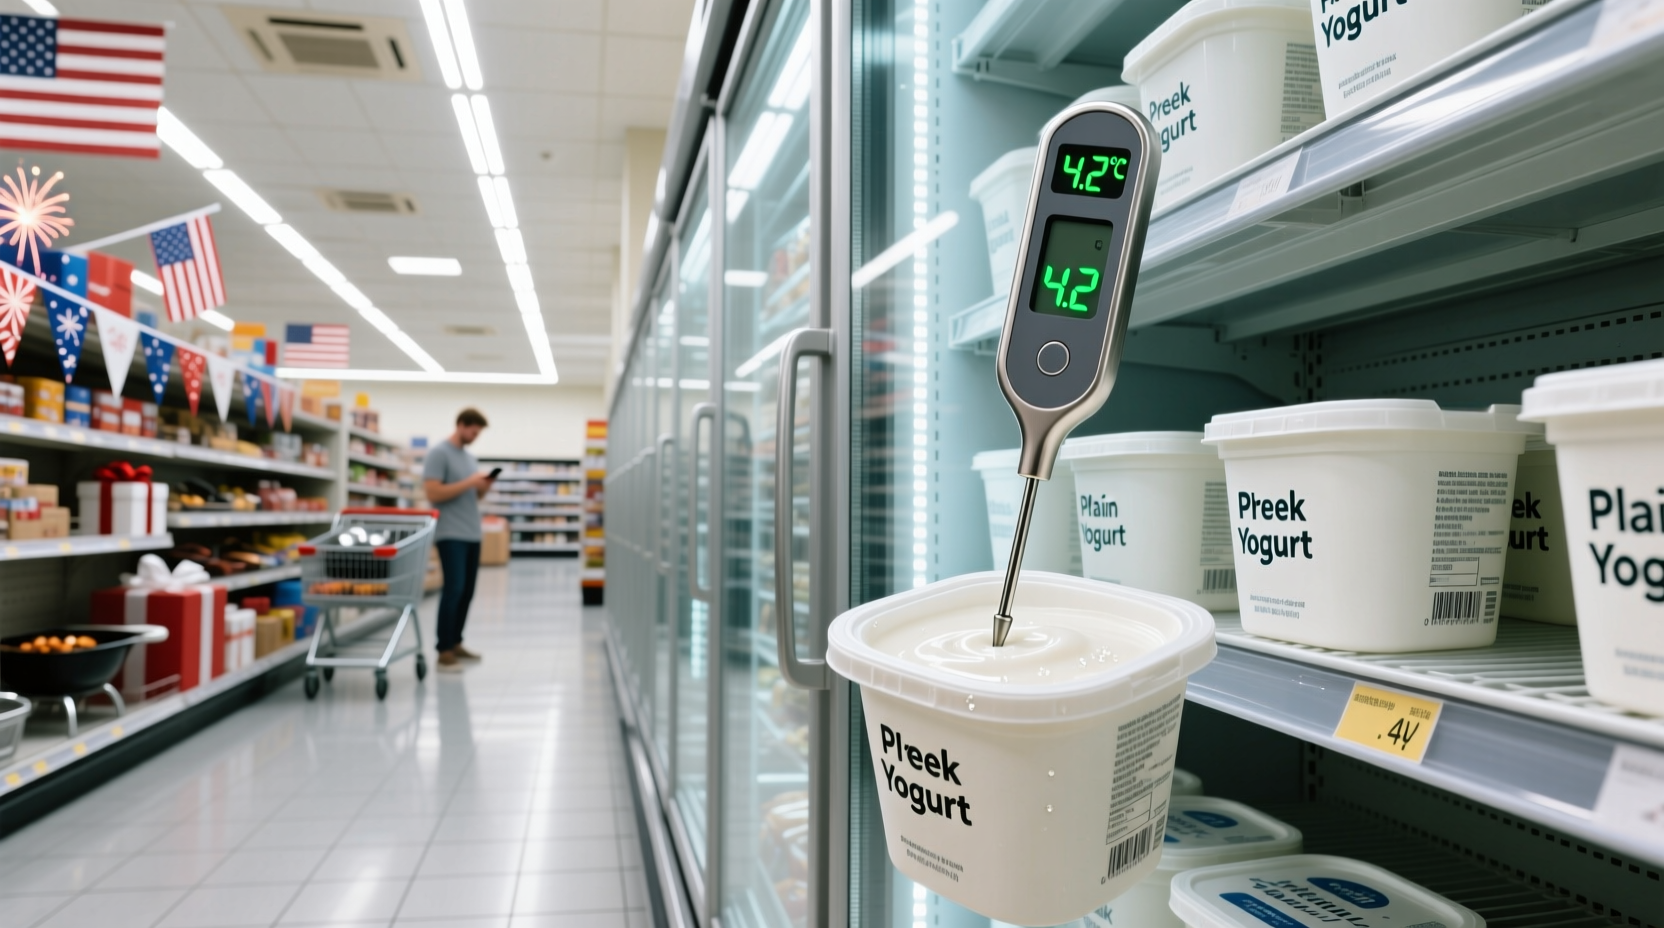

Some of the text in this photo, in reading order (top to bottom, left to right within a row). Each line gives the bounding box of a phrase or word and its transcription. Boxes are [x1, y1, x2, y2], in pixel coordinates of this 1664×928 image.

[1157, 109, 1197, 153] gurt
[1043, 264, 1100, 312] 4.2
[1080, 494, 1118, 518] Plain
[1589, 487, 1664, 534] Plai
[1081, 522, 1127, 552] Yogurt
[1237, 526, 1313, 566] Yogurt
[1508, 526, 1550, 552] urt
[1588, 543, 1664, 603] Yog
[880, 757, 973, 827] Yogurt
